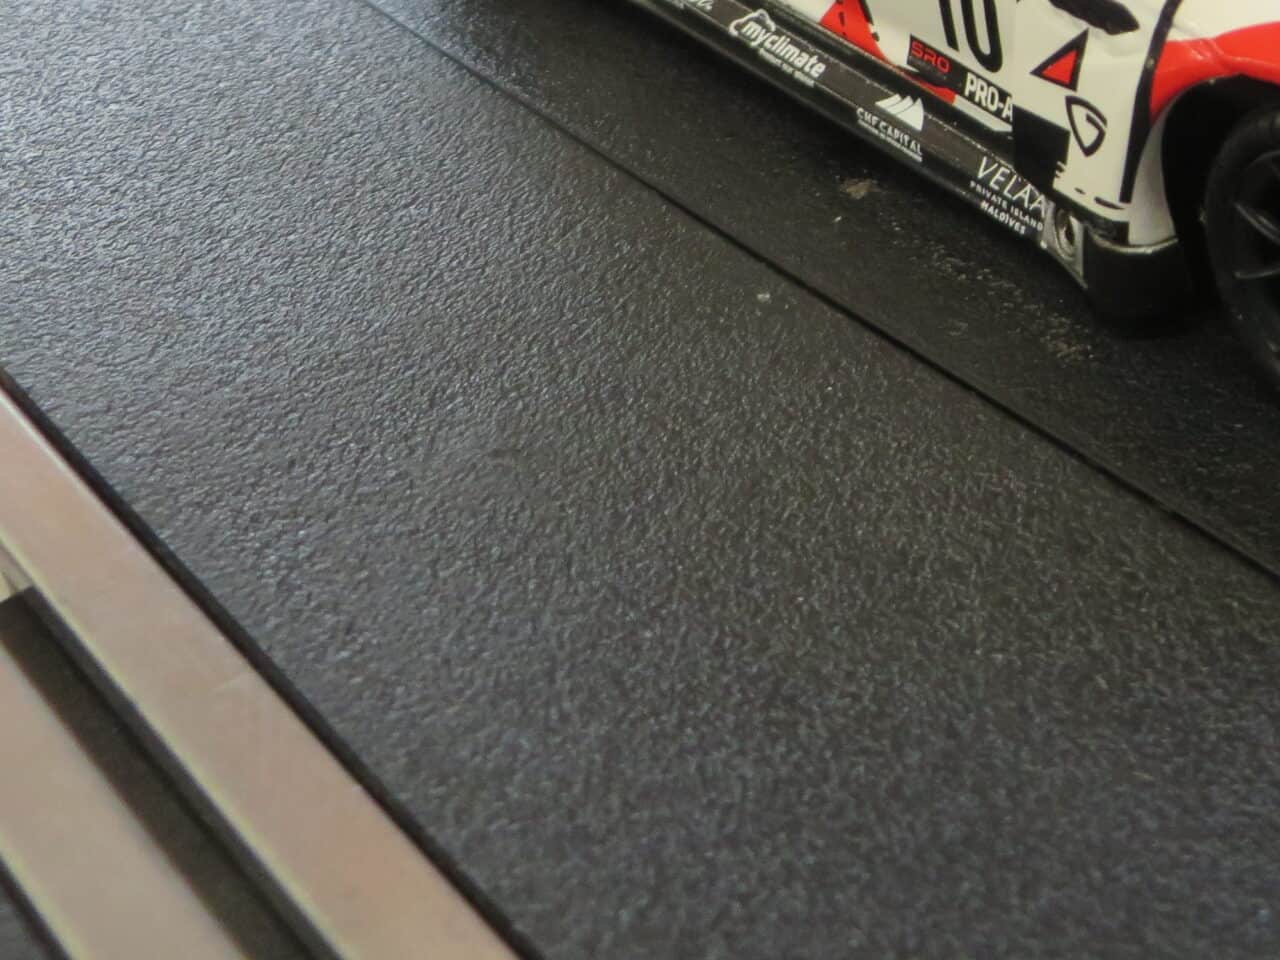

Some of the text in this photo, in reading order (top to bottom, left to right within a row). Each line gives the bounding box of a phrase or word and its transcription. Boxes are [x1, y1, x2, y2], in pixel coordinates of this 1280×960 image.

[741, 21, 826, 79] myclimate
[911, 41, 951, 73] SRO
[970, 181, 1044, 232] PRIVATE ISLAND
[980, 201, 1027, 235] MALDIVES
